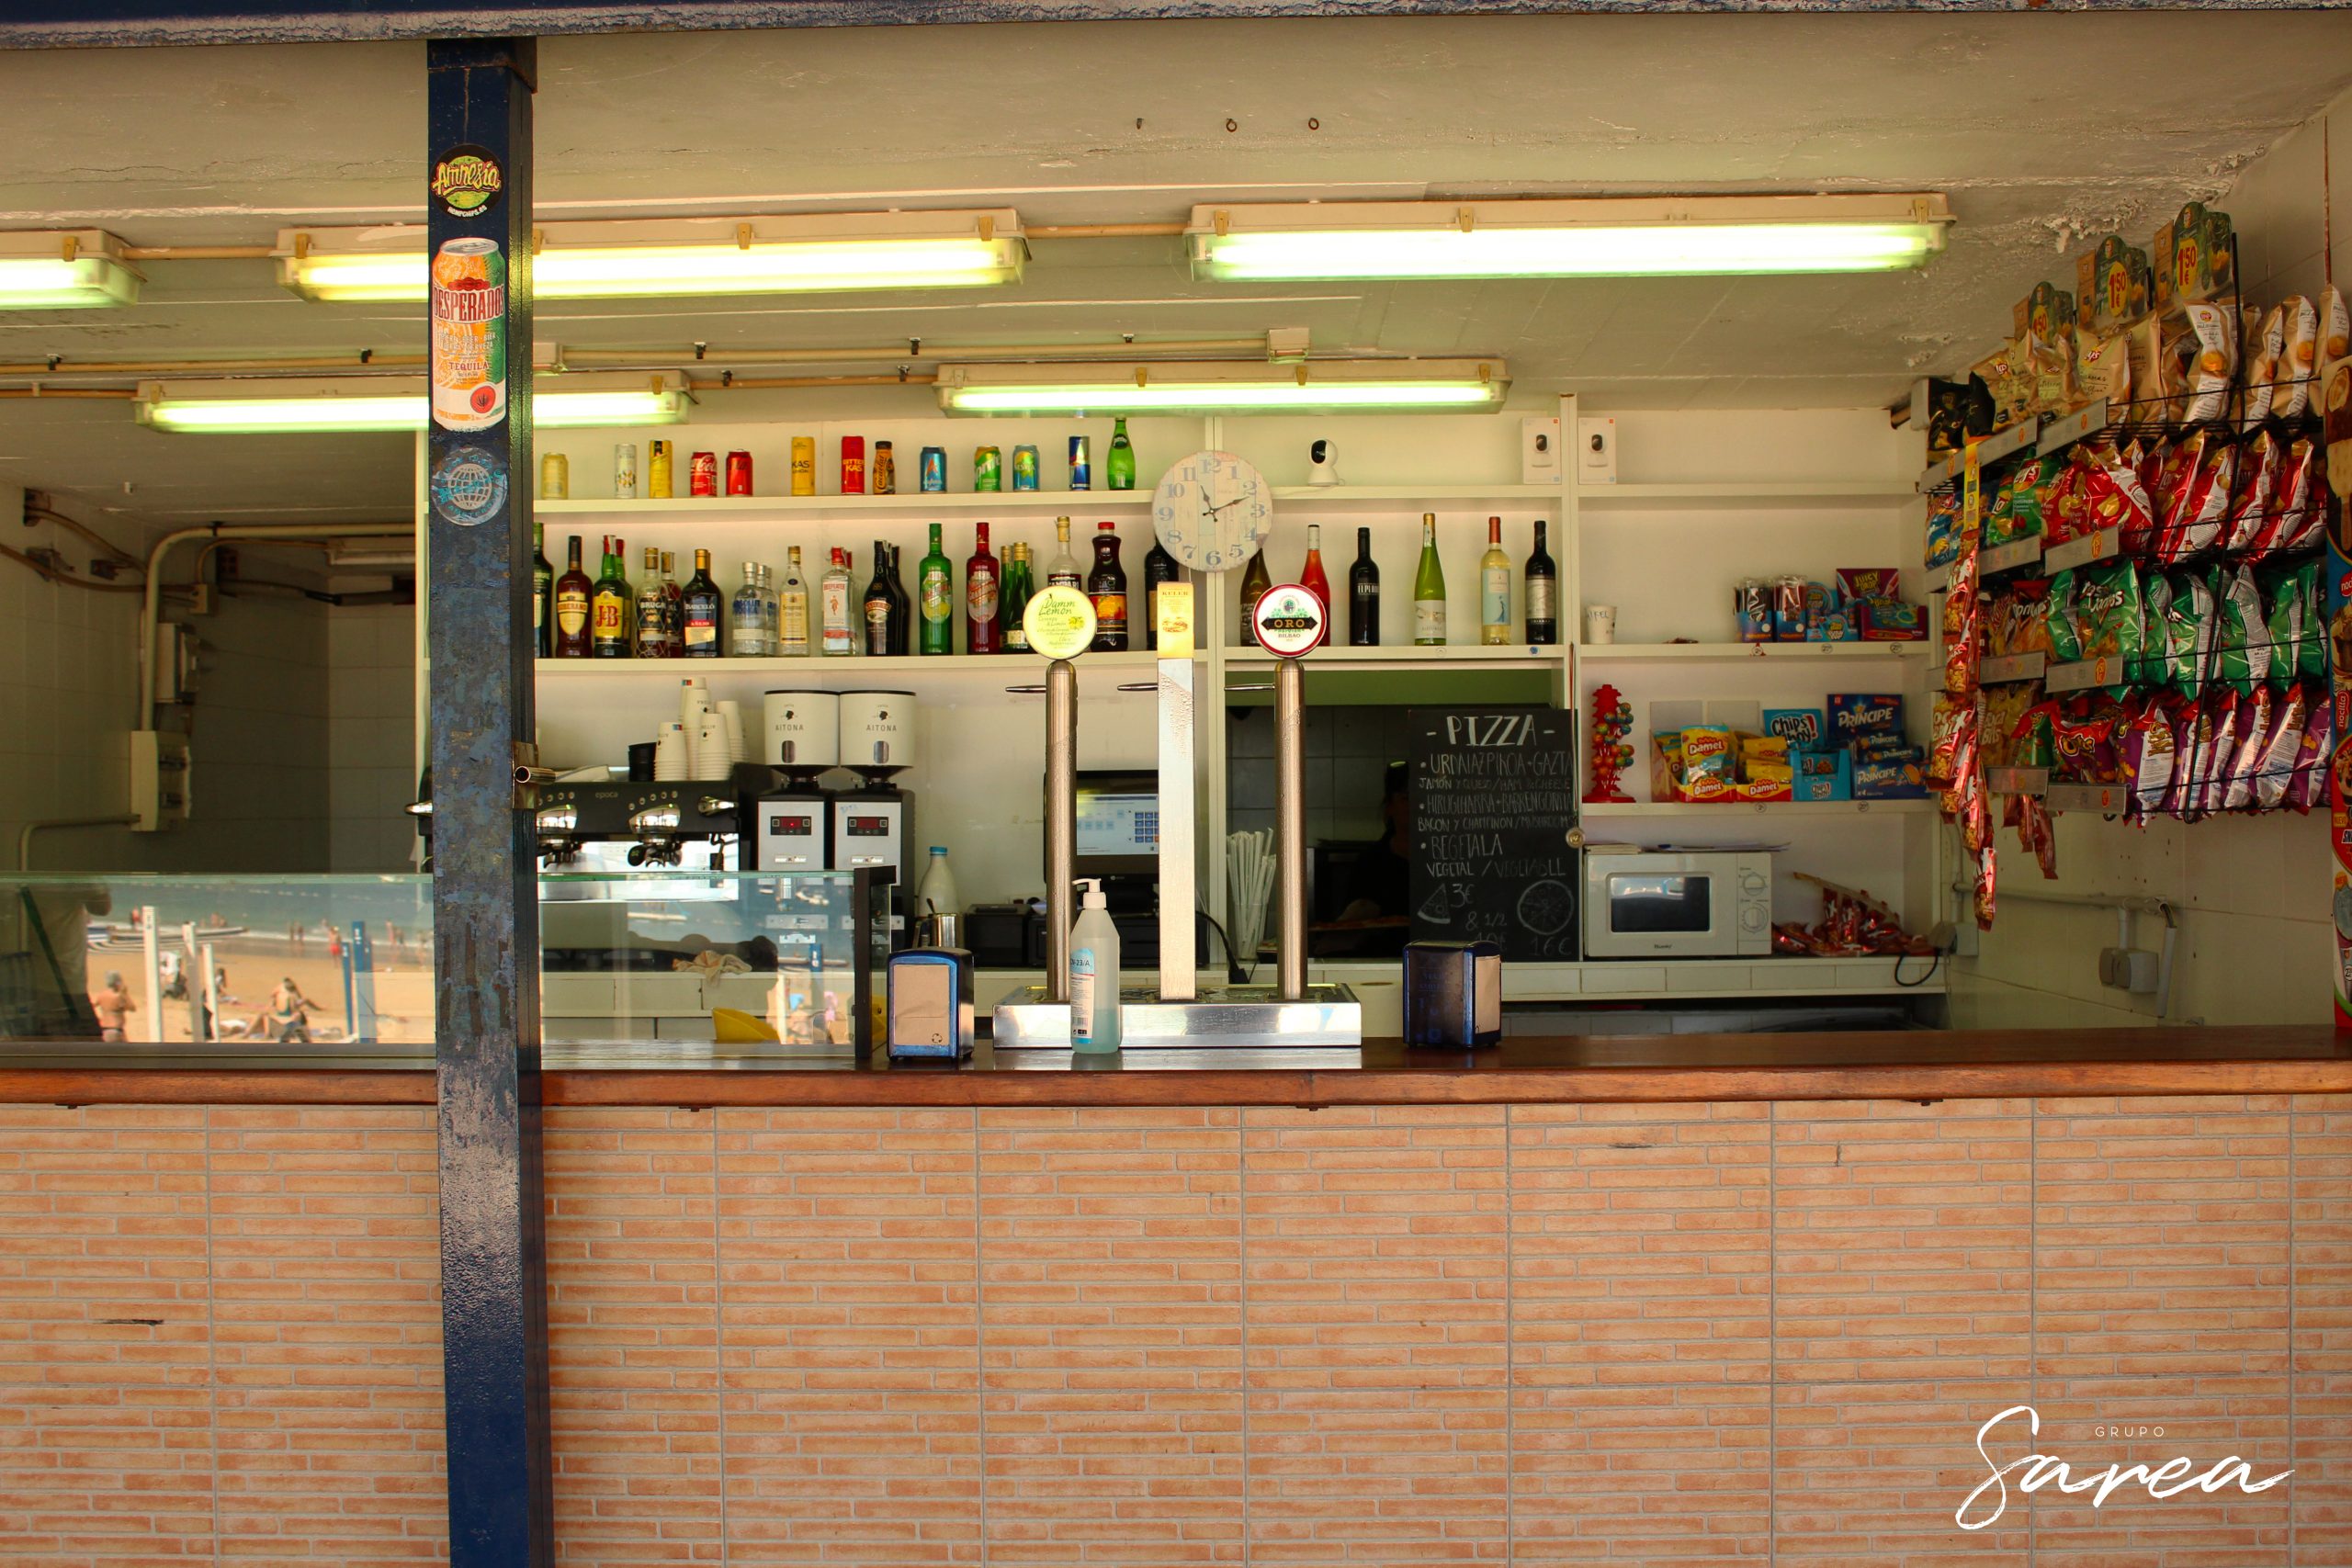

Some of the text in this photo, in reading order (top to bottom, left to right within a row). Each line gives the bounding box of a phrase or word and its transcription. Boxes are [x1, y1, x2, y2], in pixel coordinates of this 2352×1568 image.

[432, 160, 501, 196] Amnesia
[434, 285, 505, 321] DESPERADOS
[448, 362, 489, 371] TEQUILA
[791, 460, 810, 468] KAS
[1199, 458, 1222, 474] 12
[1182, 467, 1198, 482] 11
[1228, 465, 1240, 480] 1
[1162, 483, 1185, 499] 10
[1243, 480, 1258, 496] 2
[1158, 507, 1174, 522] 9
[1250, 503, 1265, 518] 3
[1167, 530, 1182, 545] 8
[1243, 527, 1257, 542] 4
[1182, 545, 1197, 559] 7
[1205, 550, 1222, 566] 6
[1228, 544, 1244, 558] 5
[1045, 594, 1076, 609] Damm
[1038, 604, 1072, 616] Lemon
[1273, 618, 1305, 629] ORO
[866, 724, 897, 732] AITONA
[1446, 714, 1537, 747] PIZZA
[1689, 741, 1724, 755] Damel
[1419, 776, 1453, 790] JAMÓN
[1694, 783, 1723, 795] Damel
[1749, 783, 1778, 795] Damel
[1418, 817, 1450, 832] BACON
[1431, 833, 1503, 861] BEGETALA
[1426, 862, 1475, 878] VEGETAL
